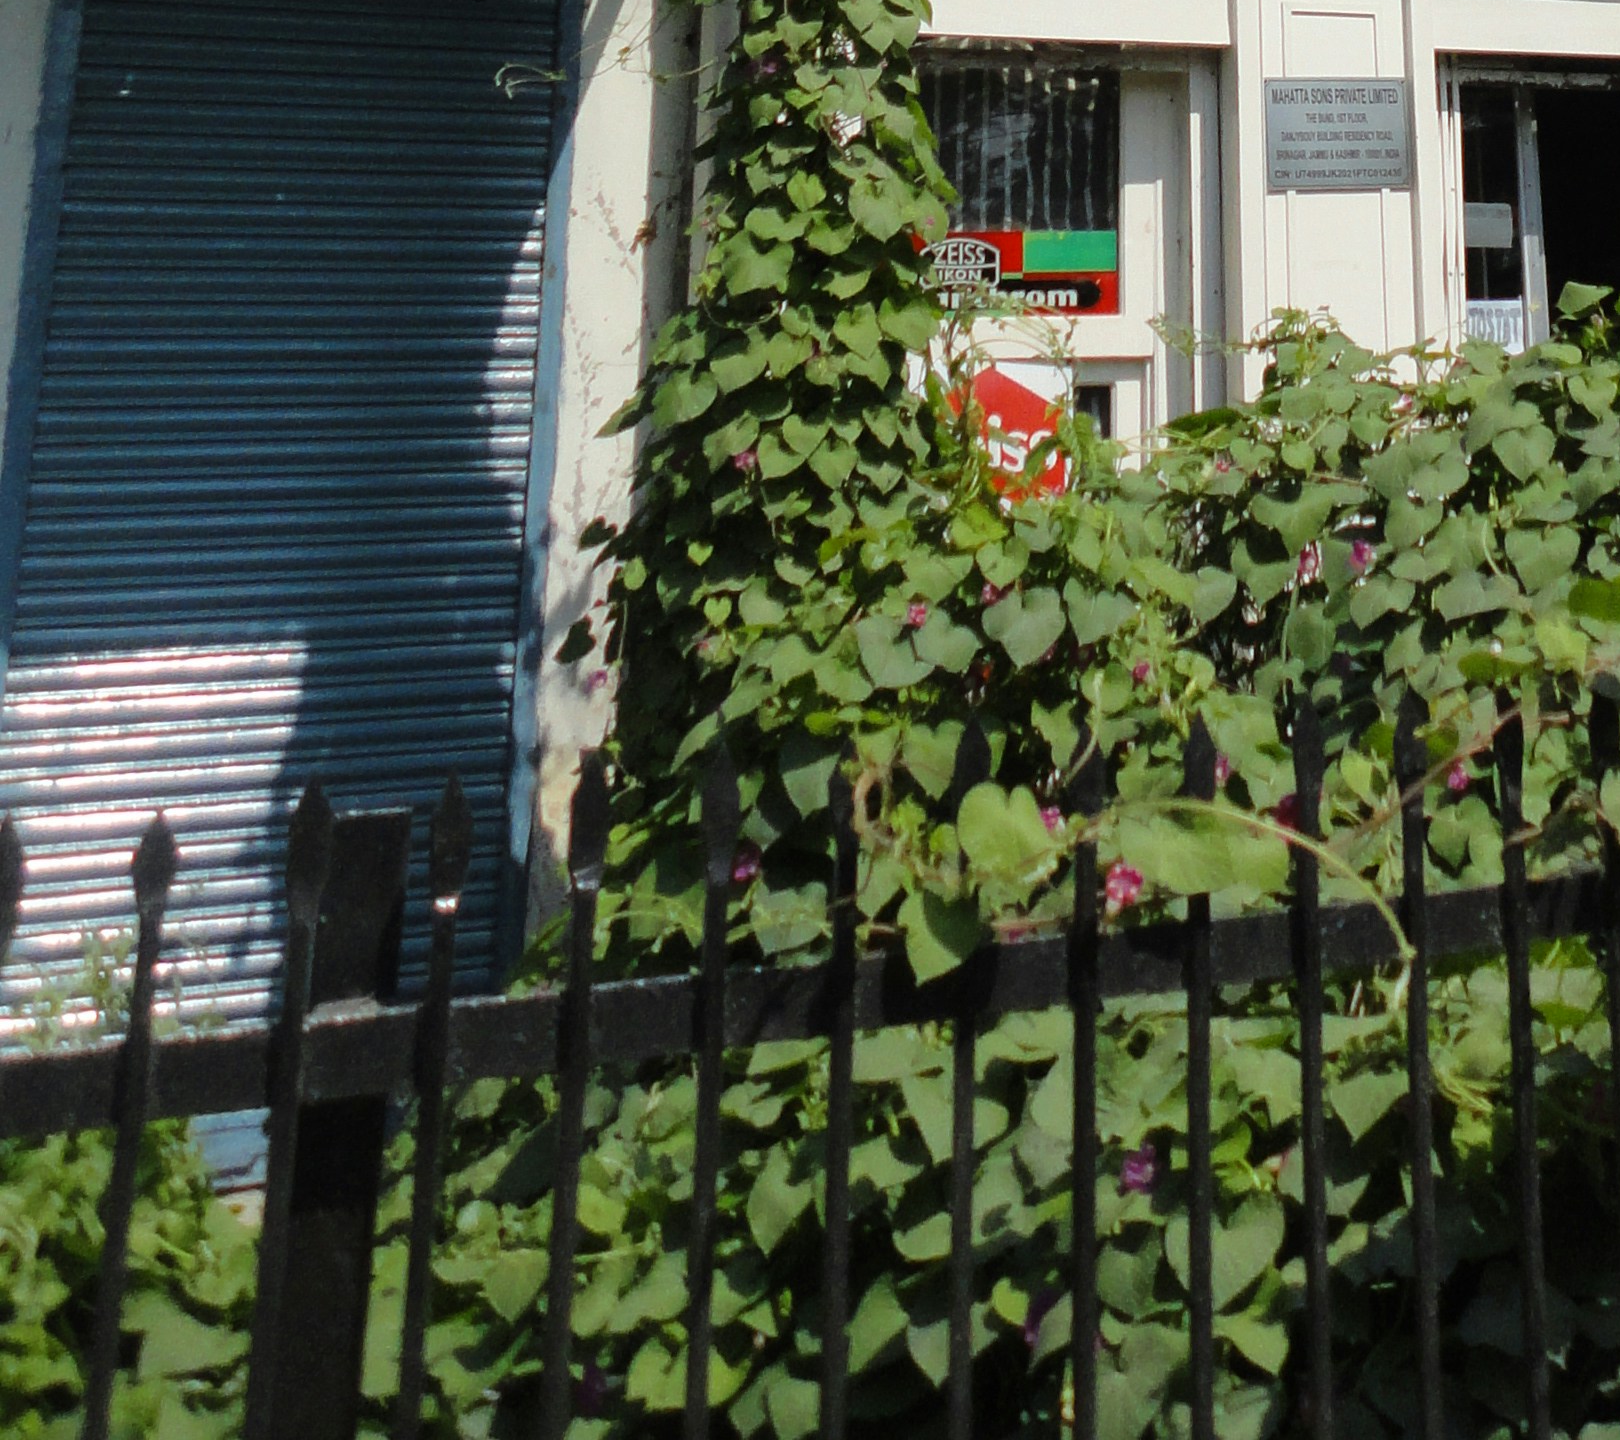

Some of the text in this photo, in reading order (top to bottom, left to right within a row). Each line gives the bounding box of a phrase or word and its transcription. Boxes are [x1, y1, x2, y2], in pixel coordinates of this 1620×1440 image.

[1271, 87, 1399, 105] MAHATTA SONS PRIVATE LIMITED
[934, 243, 986, 266] ZEISS
[938, 268, 982, 282] IKON
